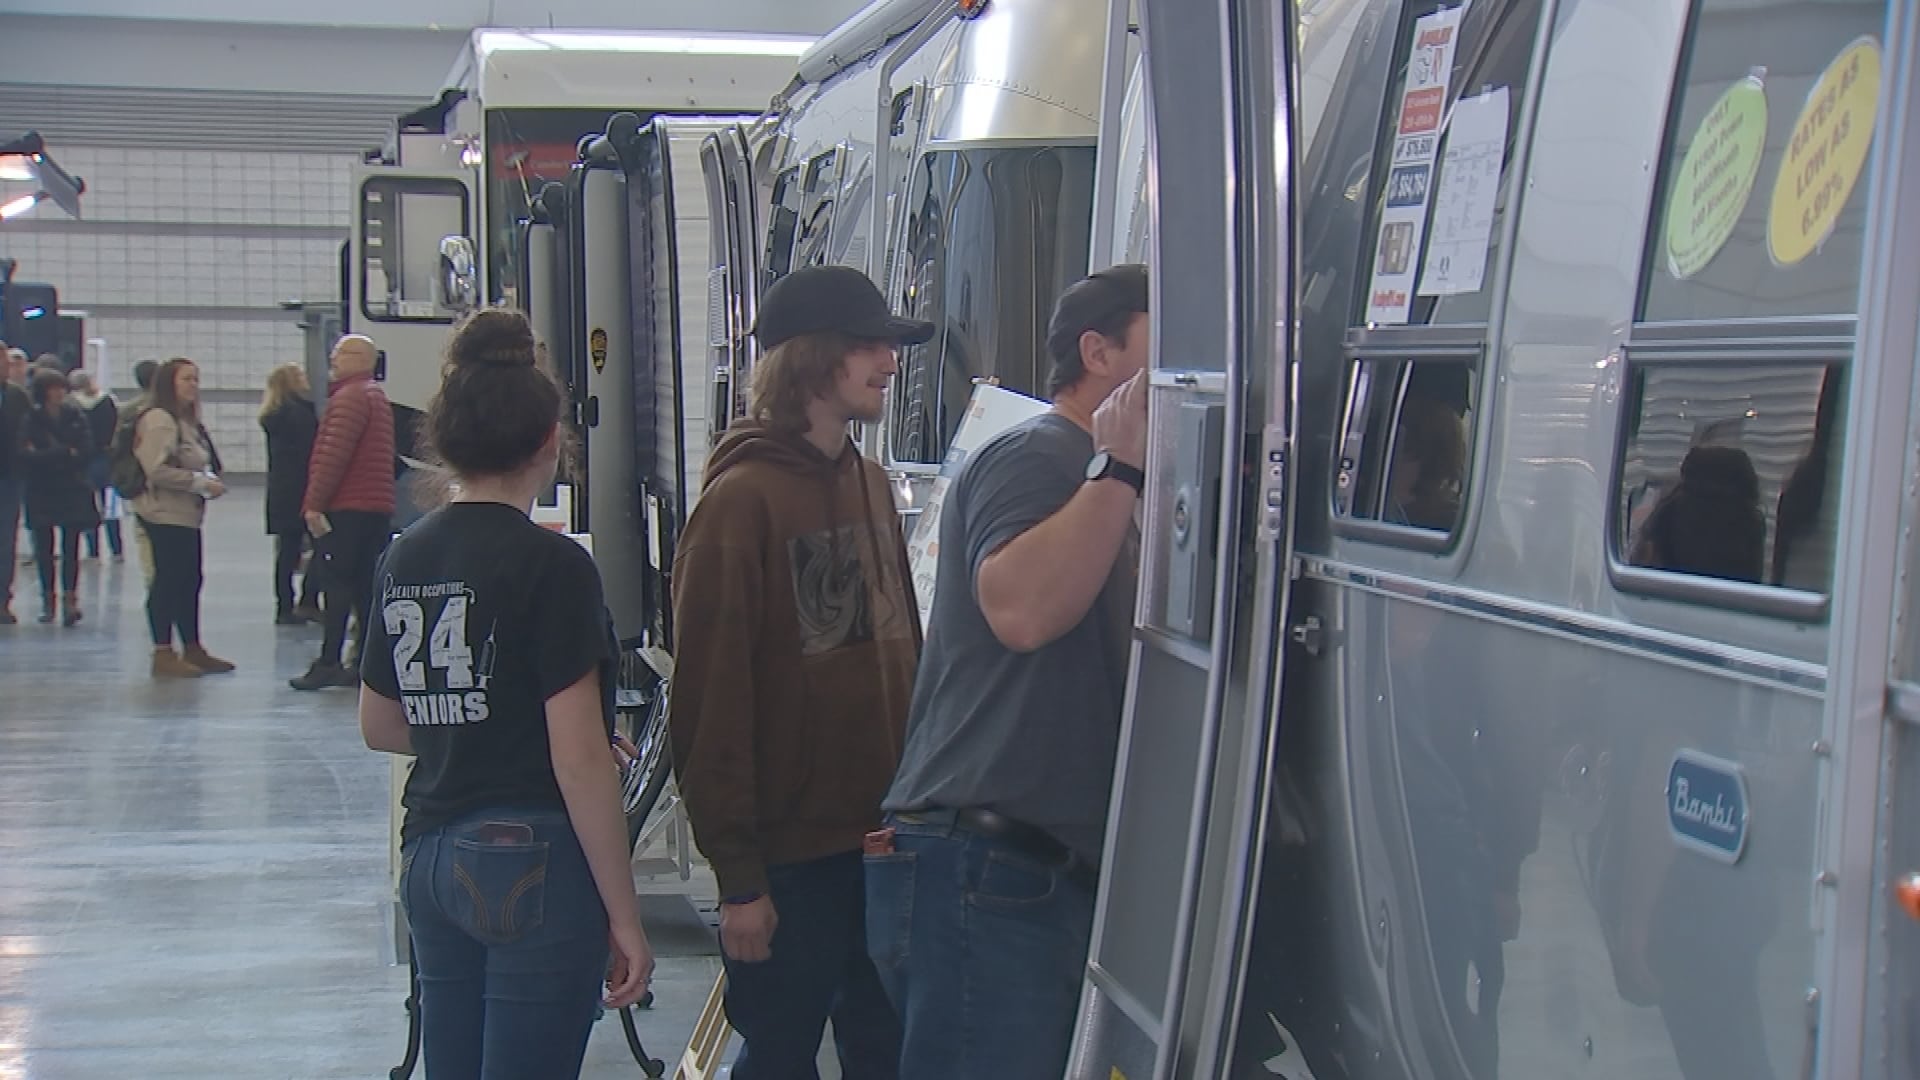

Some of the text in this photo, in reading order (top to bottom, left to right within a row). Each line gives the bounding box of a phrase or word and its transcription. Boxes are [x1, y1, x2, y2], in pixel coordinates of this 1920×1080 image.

[1790, 52, 1859, 164] RATES AS
[1796, 109, 1850, 198] LOW AS
[391, 585, 421, 599] HEALTH
[383, 595, 474, 691] 24
[401, 690, 490, 725] ENIORS
[1673, 777, 1737, 833] Bambi
